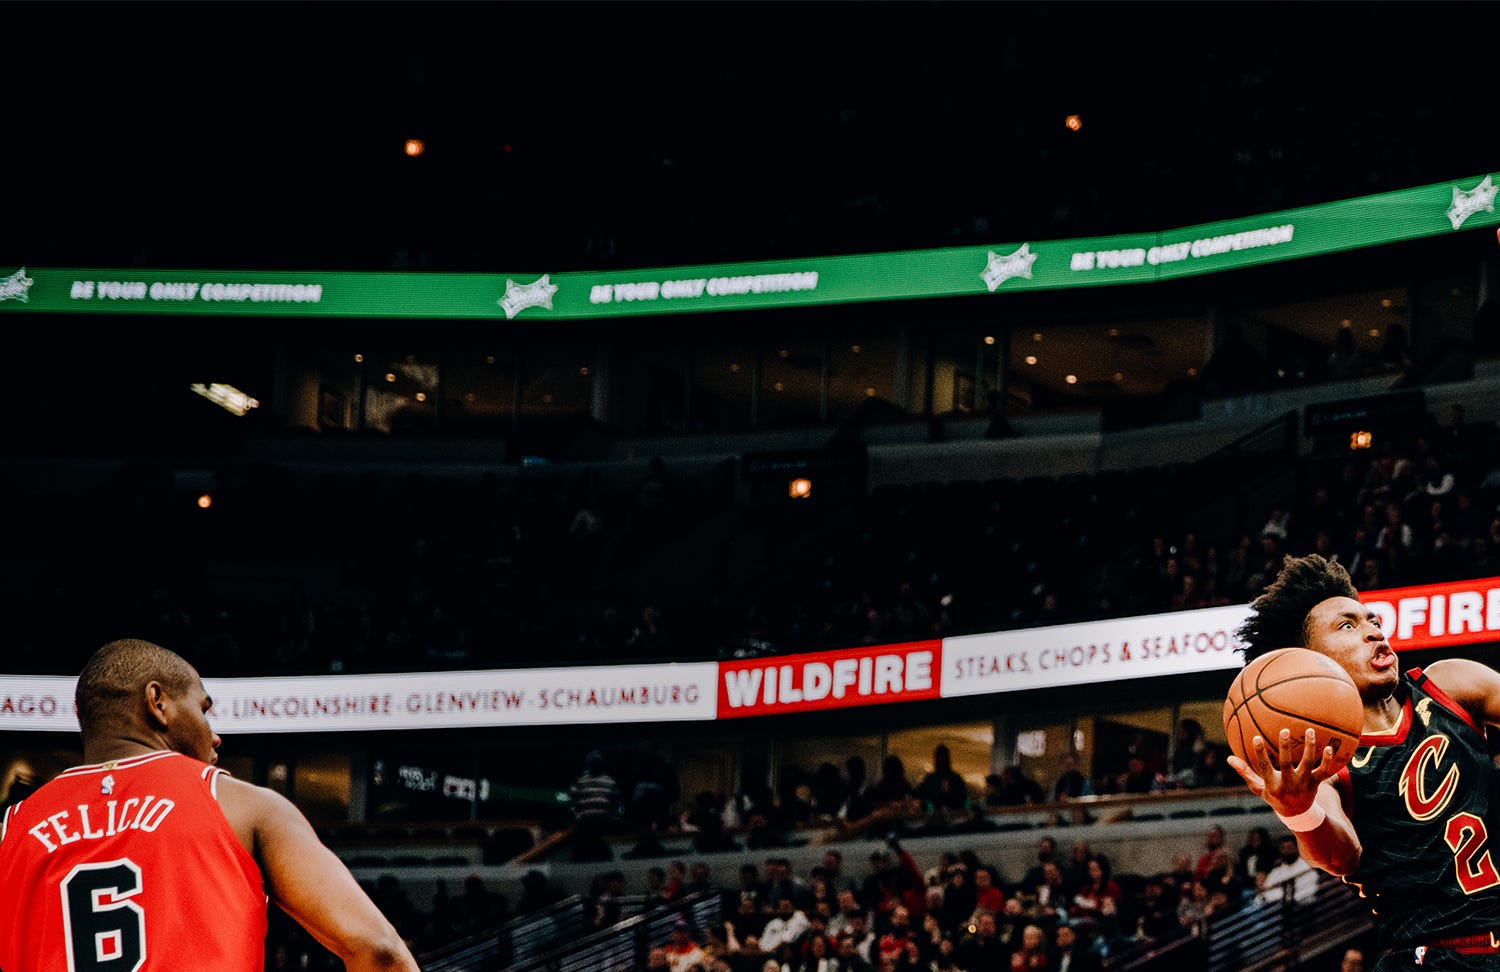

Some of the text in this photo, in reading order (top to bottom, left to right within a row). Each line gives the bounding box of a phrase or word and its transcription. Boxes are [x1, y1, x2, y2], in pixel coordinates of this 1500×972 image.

[1, 696, 57, 716] AGO
[233, 694, 392, 719] LINCOLNSHIRE
[405, 689, 526, 714] GLENVIEW
[538, 684, 699, 709] SCHAUMBURG
[725, 651, 933, 708] WILDFIRE
[1039, 642, 1111, 672] CHOPS
[1120, 641, 1132, 663] &
[1399, 734, 1460, 821] C
[29, 795, 175, 853] FELICIO
